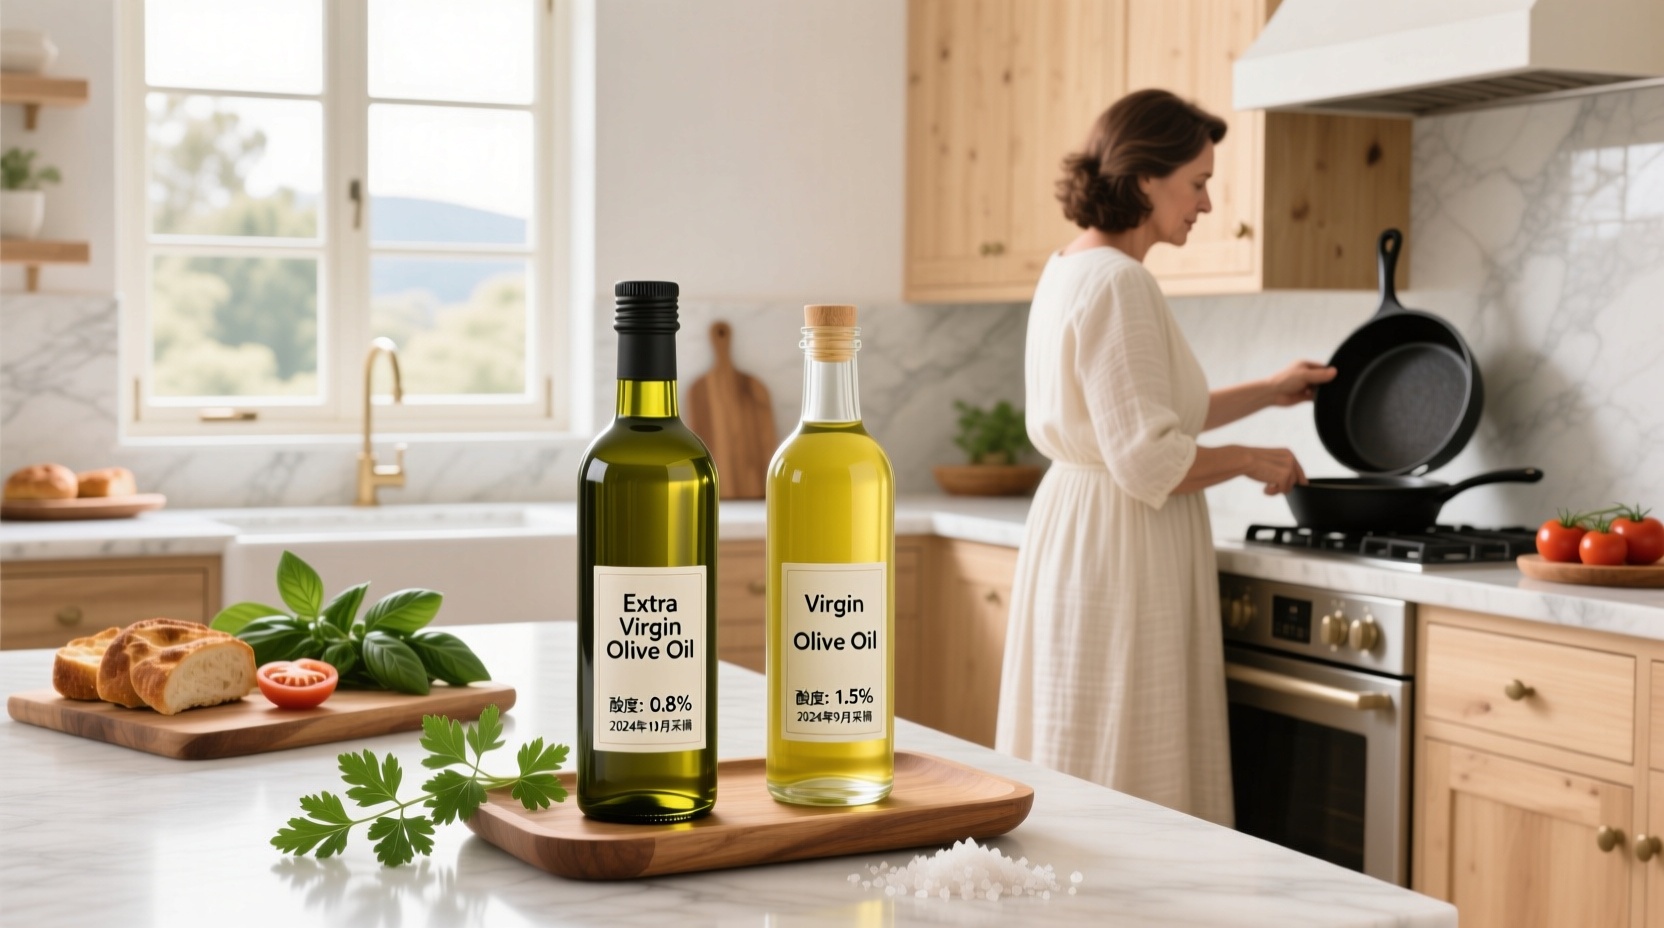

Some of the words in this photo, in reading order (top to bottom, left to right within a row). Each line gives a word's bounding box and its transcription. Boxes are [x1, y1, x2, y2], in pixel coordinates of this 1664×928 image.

[623, 593, 678, 613] Extra
[804, 594, 864, 618] Virgin
[619, 616, 682, 641] Virgin
[606, 640, 661, 660] Olive
[666, 639, 694, 660] Oil
[793, 631, 846, 651] Olive
[850, 630, 877, 650] Oil
[649, 694, 693, 713] 0.8%
[834, 687, 874, 705] 1.5%
